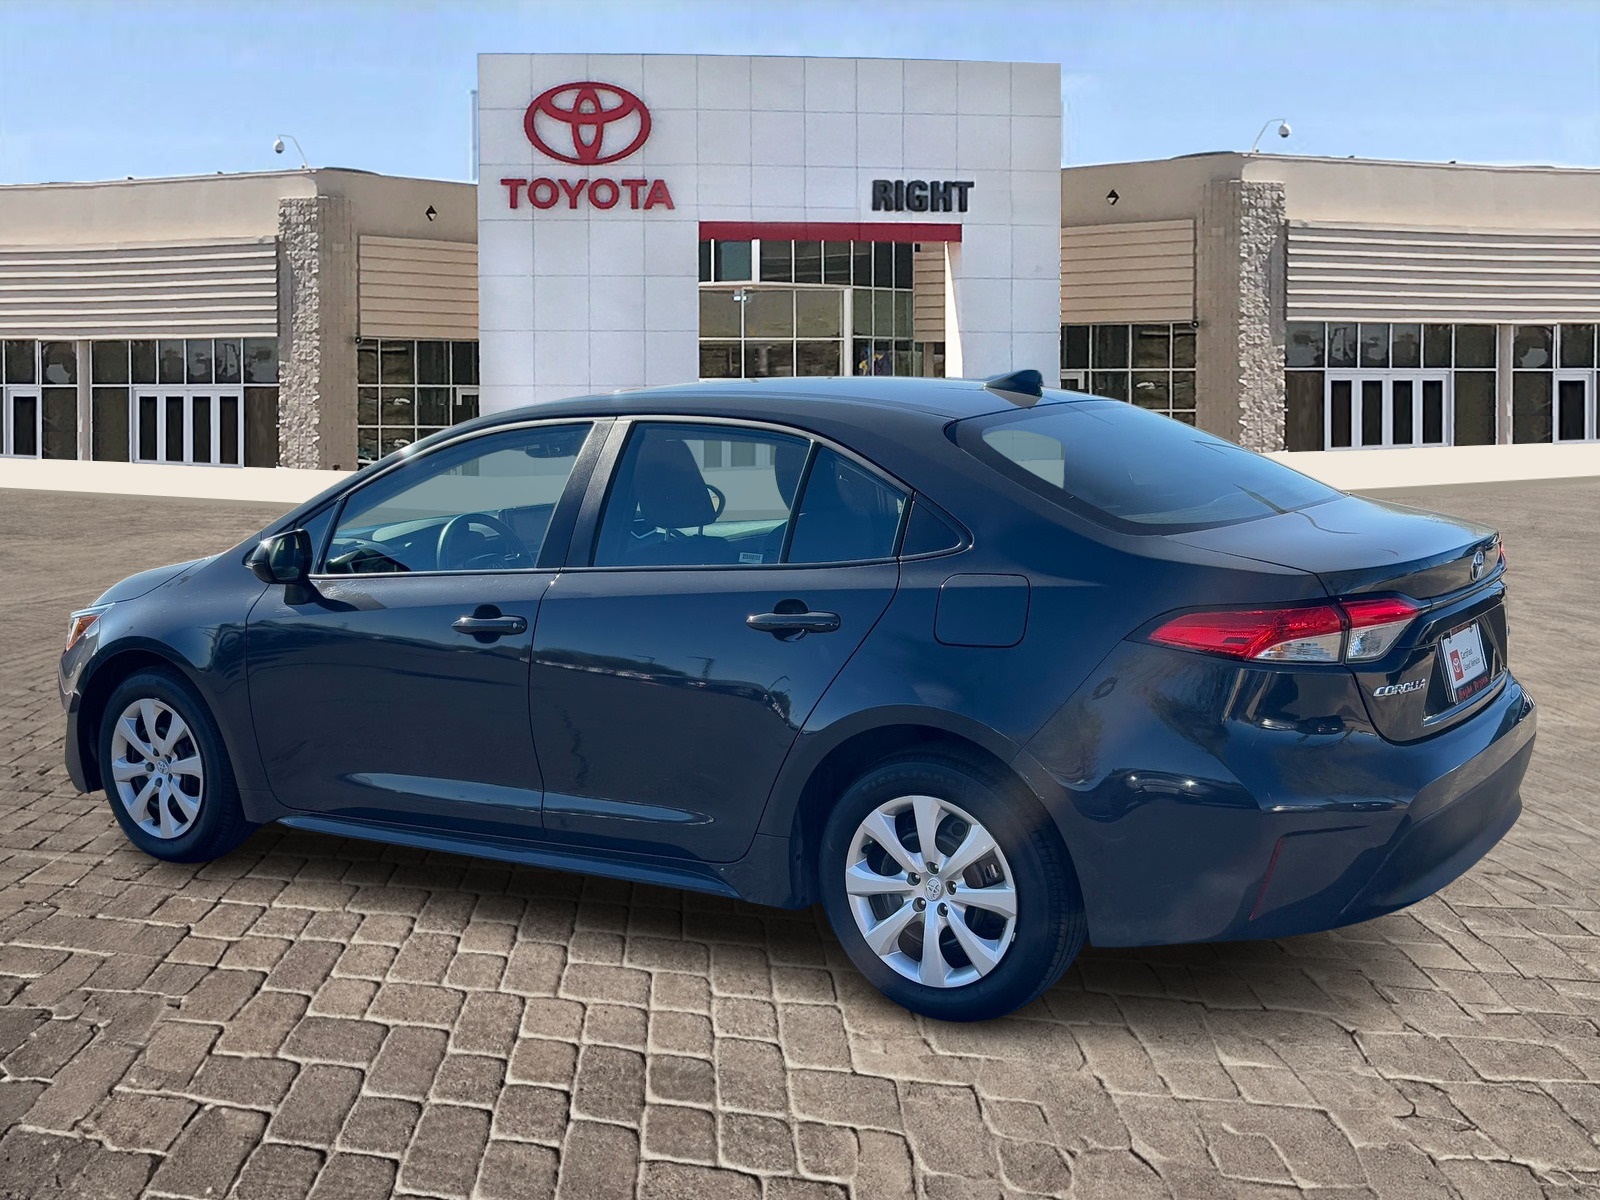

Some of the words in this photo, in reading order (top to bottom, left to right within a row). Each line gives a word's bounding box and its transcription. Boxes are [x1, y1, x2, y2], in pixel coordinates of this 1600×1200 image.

[500, 178, 675, 210] TOYOTA
[872, 179, 975, 212] RIGHT
[1373, 678, 1426, 697] COROLLA
